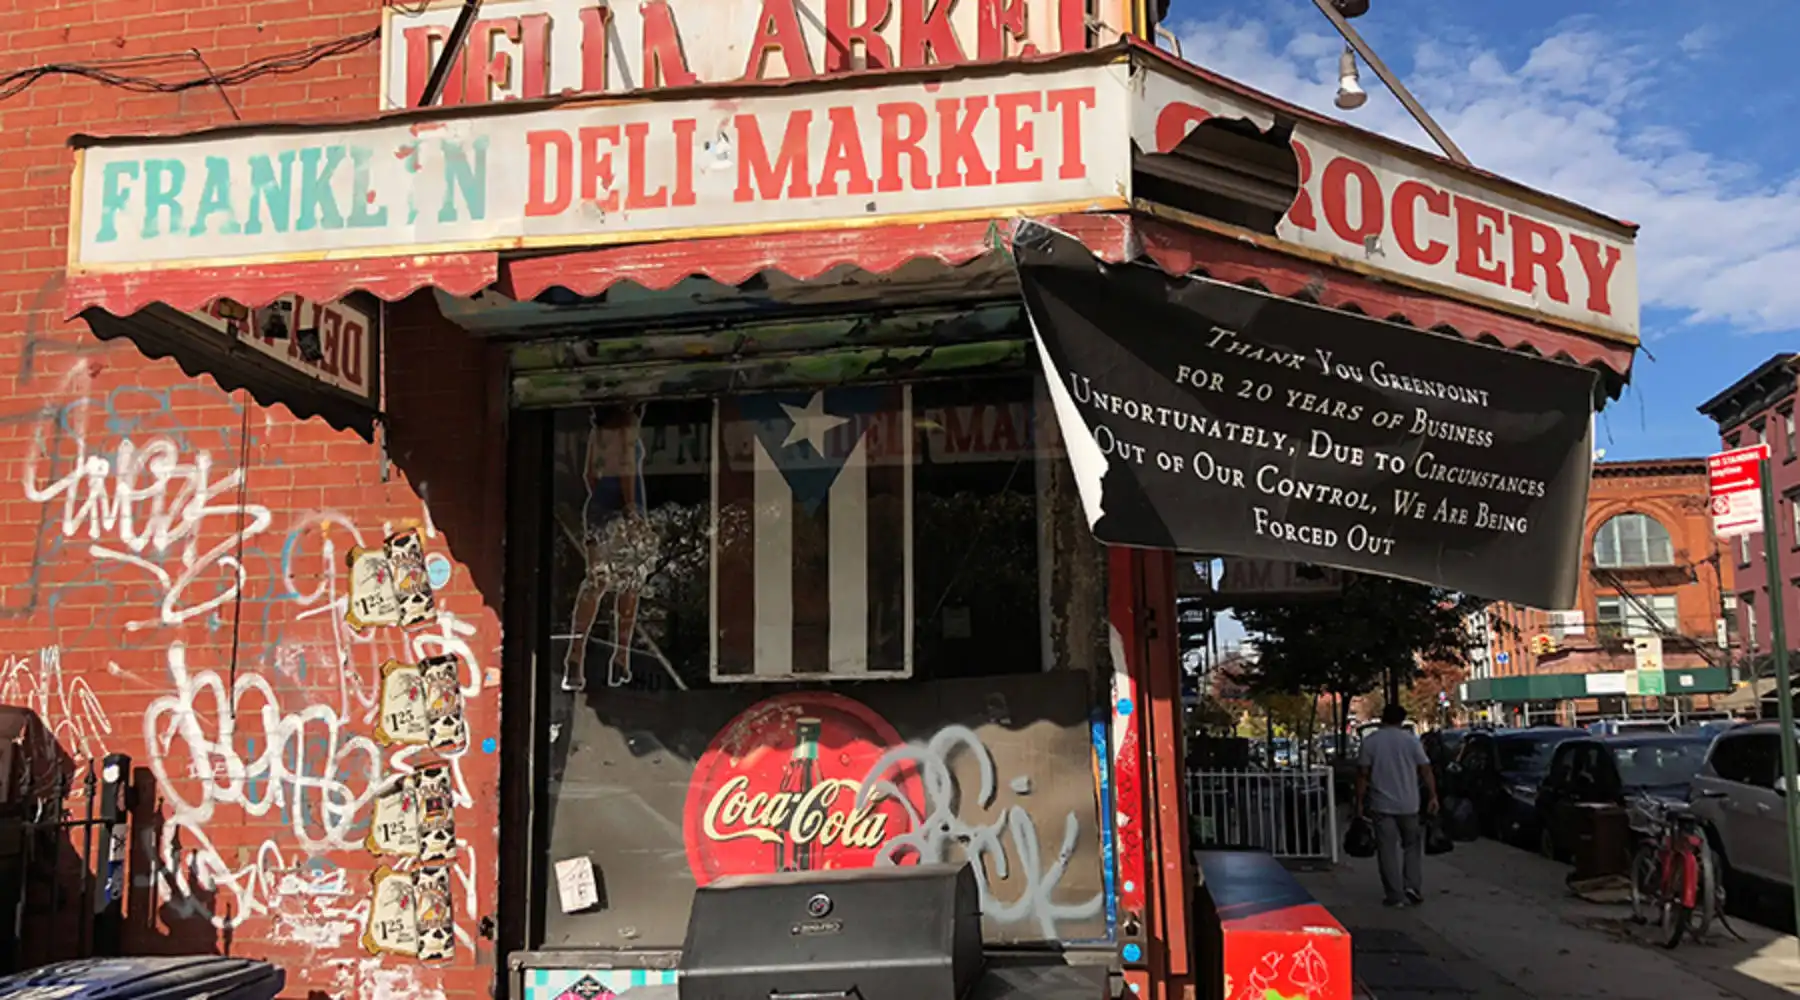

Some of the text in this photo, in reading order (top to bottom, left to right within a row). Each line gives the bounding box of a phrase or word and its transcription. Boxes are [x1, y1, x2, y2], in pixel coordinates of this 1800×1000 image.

[96, 87, 1096, 242] FRANKLN DELI MARKET
[1175, 364, 1224, 392] FOR
[1237, 379, 1273, 401] 20
[1286, 389, 1364, 421] YEARS
[1371, 411, 1404, 430] OF
[1157, 452, 1184, 474] OF
[1374, 452, 1406, 475] TO
[703, 775, 889, 850] Coca-Cola
